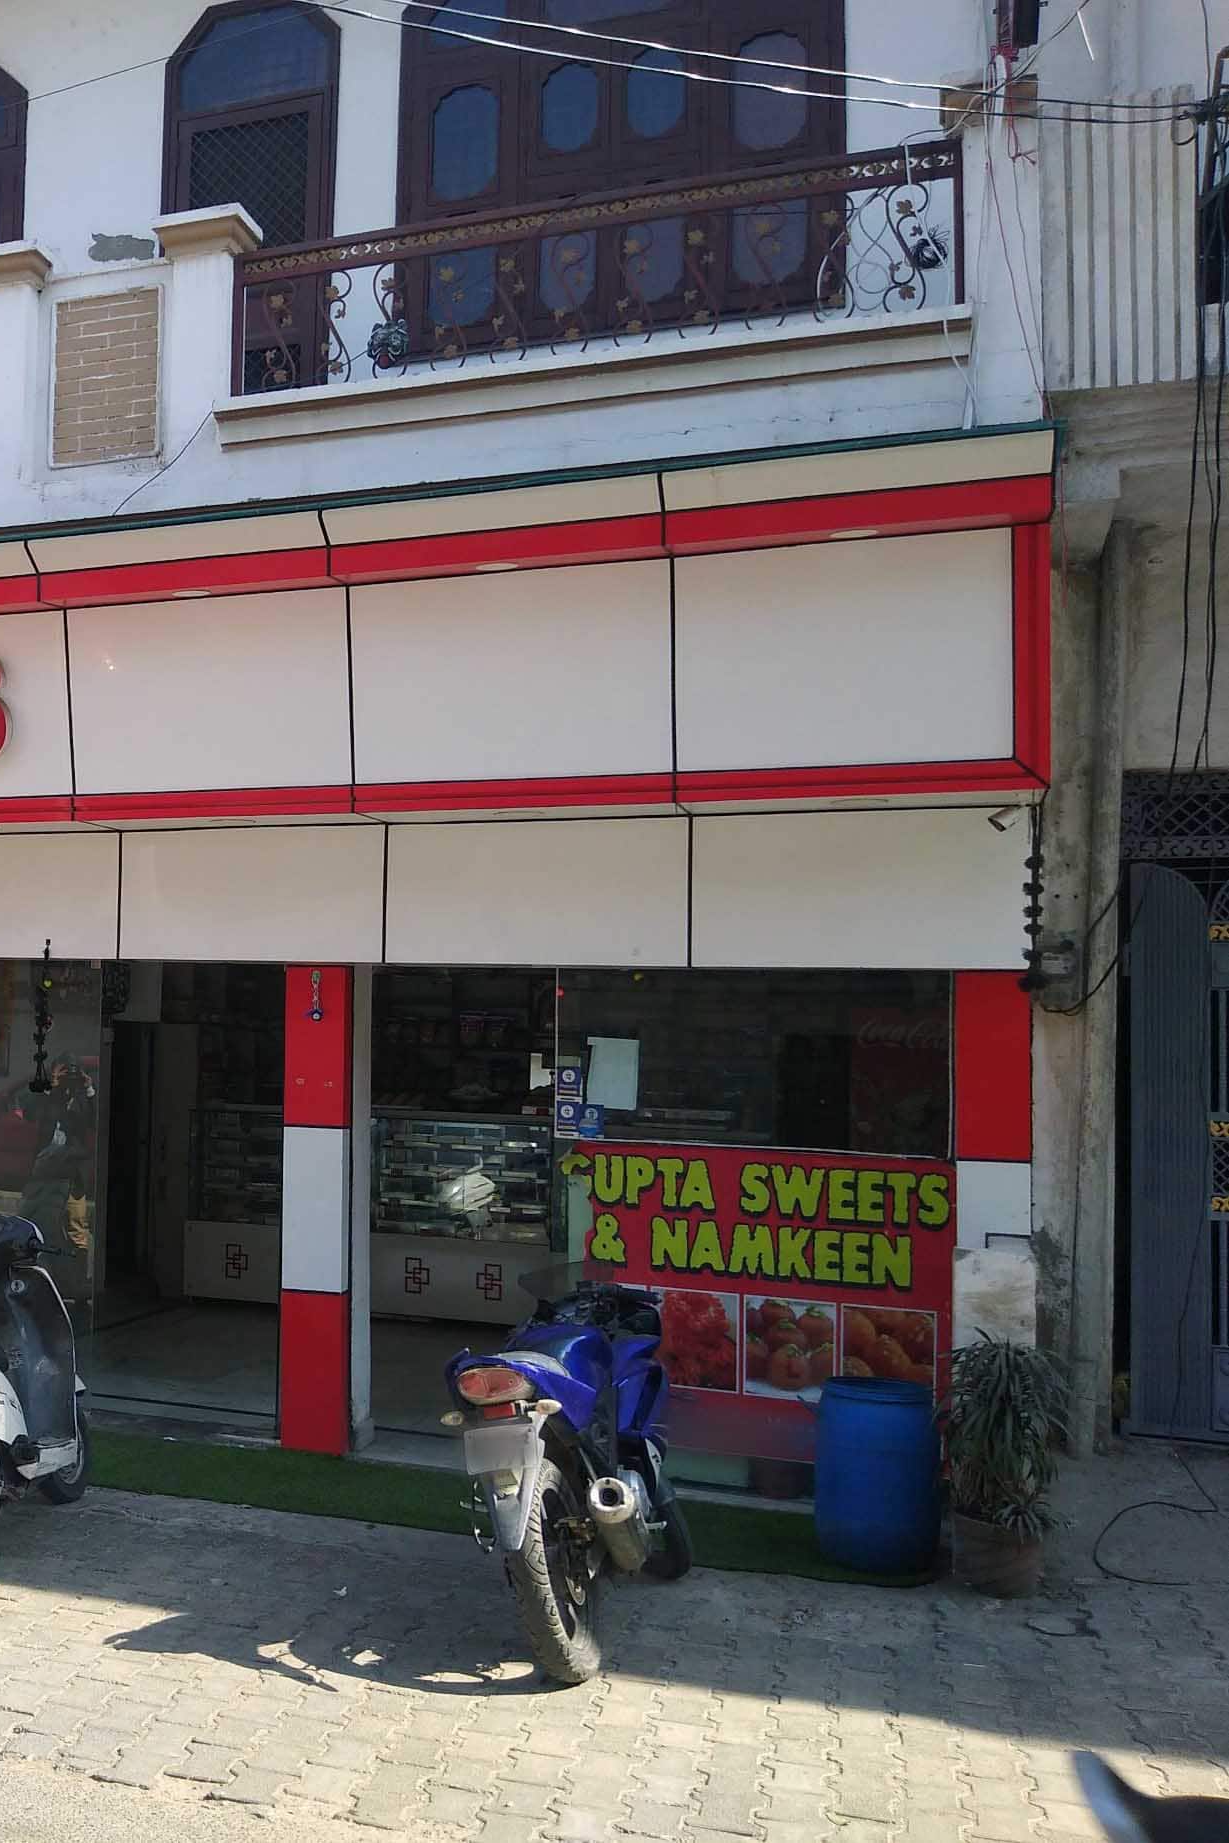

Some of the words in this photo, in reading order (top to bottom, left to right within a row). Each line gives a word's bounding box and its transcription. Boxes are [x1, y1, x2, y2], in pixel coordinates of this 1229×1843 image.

[740, 1161, 950, 1229] SWEETS
[590, 1213, 627, 1266] &
[651, 1215, 912, 1290] NAMKEEN
